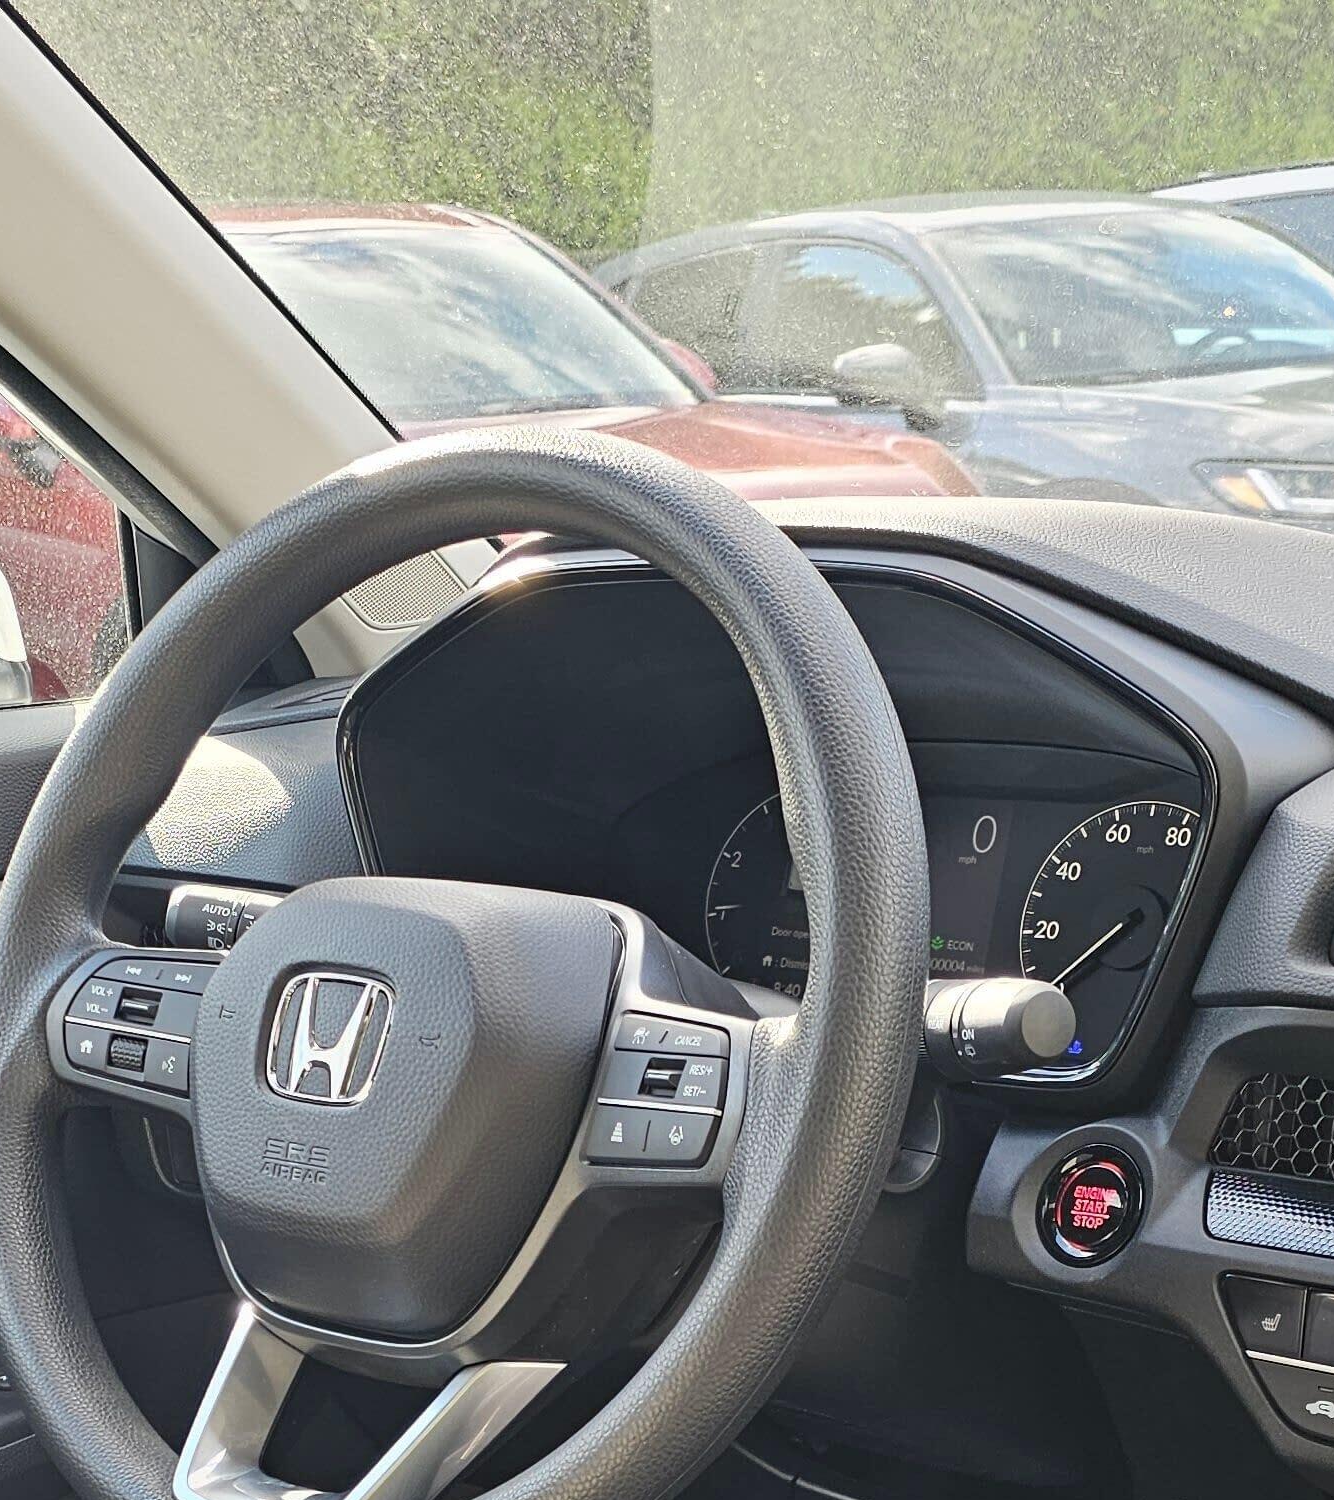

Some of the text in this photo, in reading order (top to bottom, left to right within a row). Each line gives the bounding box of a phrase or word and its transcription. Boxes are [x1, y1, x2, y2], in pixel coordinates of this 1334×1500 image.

[1105, 823, 1131, 843] 60
[1165, 827, 1192, 847] 80
[731, 851, 742, 868] 2
[1056, 862, 1081, 881] 40
[202, 903, 230, 917] AUTO
[771, 926, 792, 937] Door
[1034, 920, 1060, 940] 20
[947, 940, 974, 952] ECON
[674, 1035, 702, 1047] CANCEL
[961, 1029, 975, 1040] ON
[264, 1137, 330, 1166] SRS
[259, 1161, 328, 1186] AIRBAG
[1073, 1185, 1118, 1202] ENGINE
[1073, 1198, 1108, 1214] START
[1072, 1215, 1104, 1229] STOP
